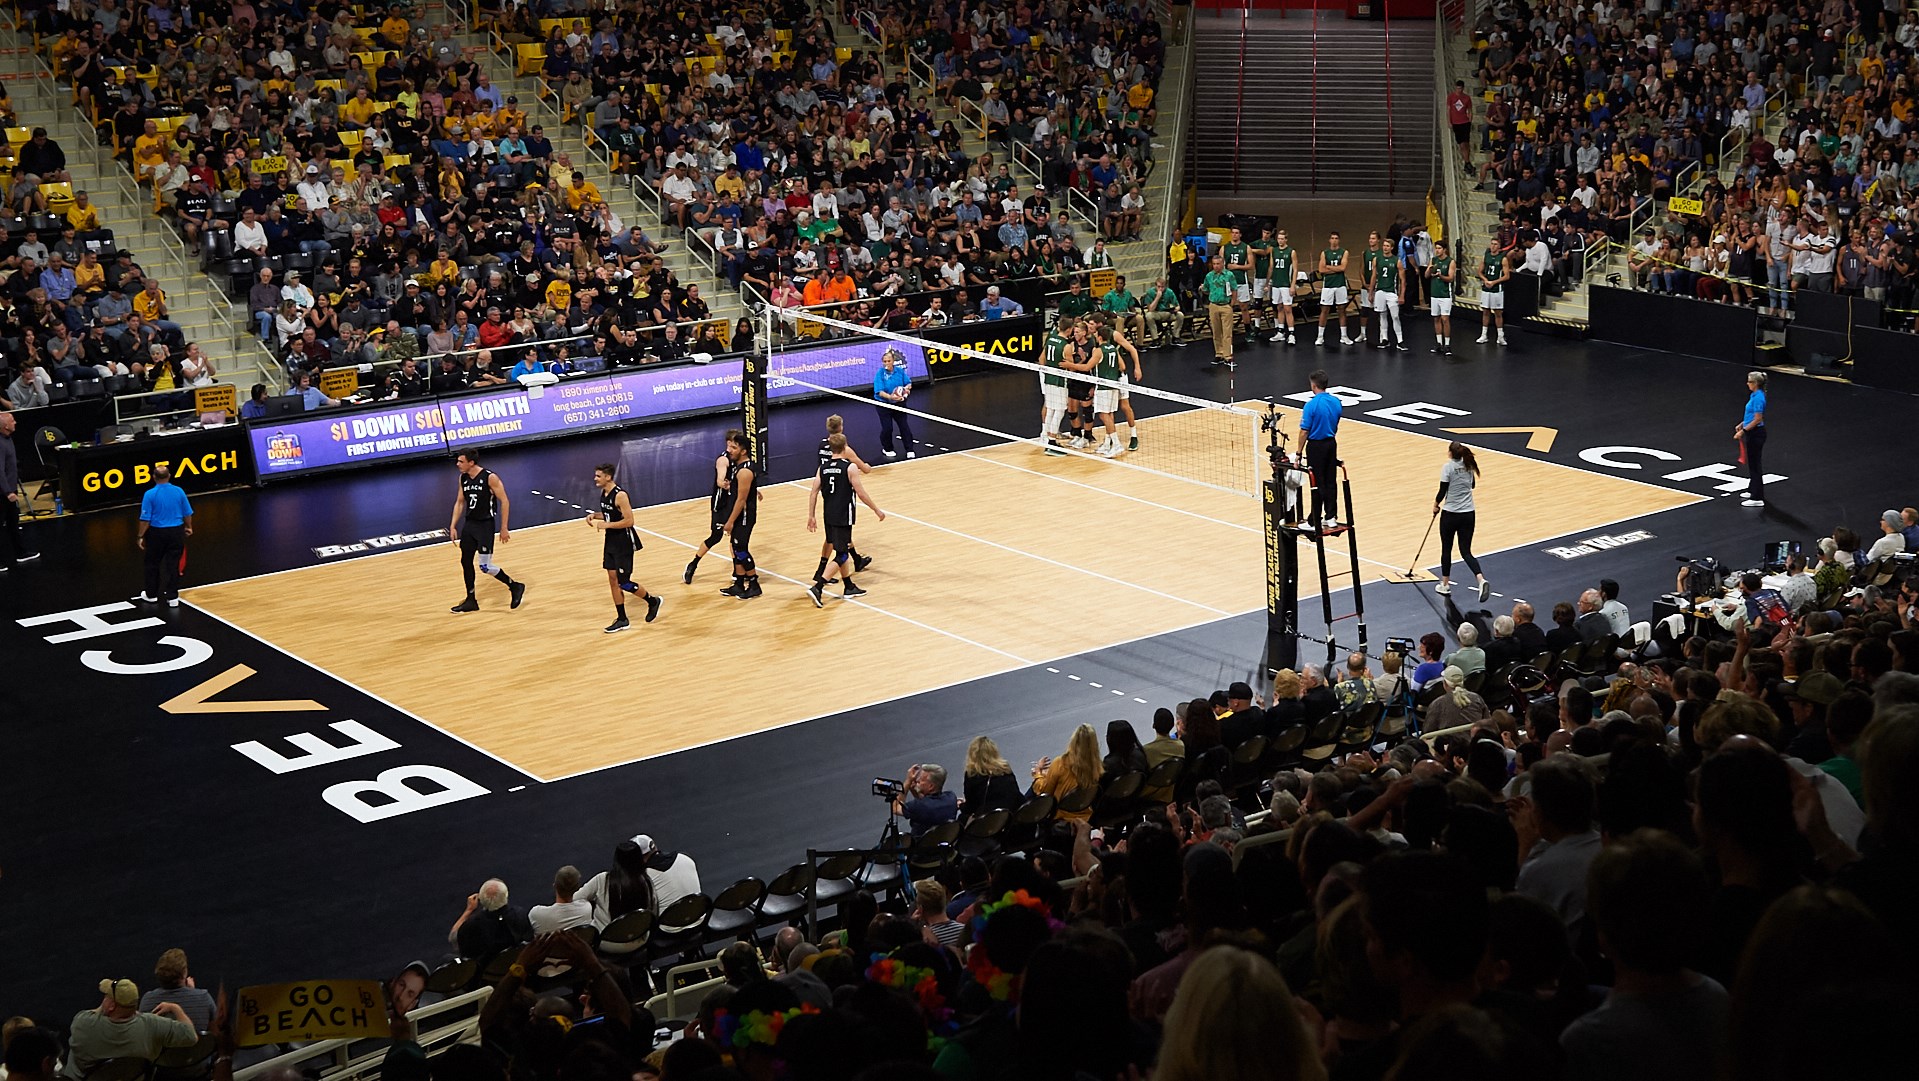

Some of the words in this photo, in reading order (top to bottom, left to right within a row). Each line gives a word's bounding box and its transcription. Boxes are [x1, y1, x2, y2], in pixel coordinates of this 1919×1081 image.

[1674, 204, 1697, 212] BEACH
[1230, 254, 1239, 264] 15
[1275, 258, 1284, 268] 20
[1382, 267, 1388, 277] 2
[927, 348, 954, 364] GO
[960, 335, 1032, 360] BEACH
[1046, 344, 1056, 362] 11
[1108, 352, 1116, 368] 17
[560, 387, 581, 398] 1890
[583, 384, 607, 396] ximeno
[608, 382, 622, 392] ave
[653, 385, 666, 394] join
[666, 381, 684, 392] today
[686, 378, 708, 389] in-club
[716, 376, 724, 384] at
[553, 403, 570, 412] long
[570, 399, 594, 409] beach,
[595, 396, 606, 406] CA
[606, 392, 634, 404] 90815
[330, 422, 348, 442] $1
[352, 414, 410, 439] DOWN
[415, 408, 447, 430] $10
[450, 404, 464, 425] A
[466, 396, 530, 422] MONTH
[588, 405, 630, 420] 341-2600
[271, 438, 292, 450] GET
[347, 442, 376, 457] FIRST
[376, 436, 413, 452] MONTH
[414, 432, 439, 448] FREE
[440, 431, 458, 442] NO
[458, 420, 522, 439] COMMITMENT
[1282, 386, 1789, 492] BEACH
[268, 447, 302, 460] DOWN
[82, 468, 124, 492] GO
[829, 476, 835, 494] 5
[1265, 512, 1273, 545] STATE
[314, 544, 368, 558] BIG
[361, 529, 448, 548] WEST
[1543, 546, 1601, 560] BIG
[1579, 530, 1656, 550] WEST
[1266, 546, 1274, 583] BEACH
[1611, 608, 1628, 620] STFF
[15, 600, 492, 824] BEACH
[289, 984, 334, 1007] GO
[254, 1007, 368, 1036] BEACH
